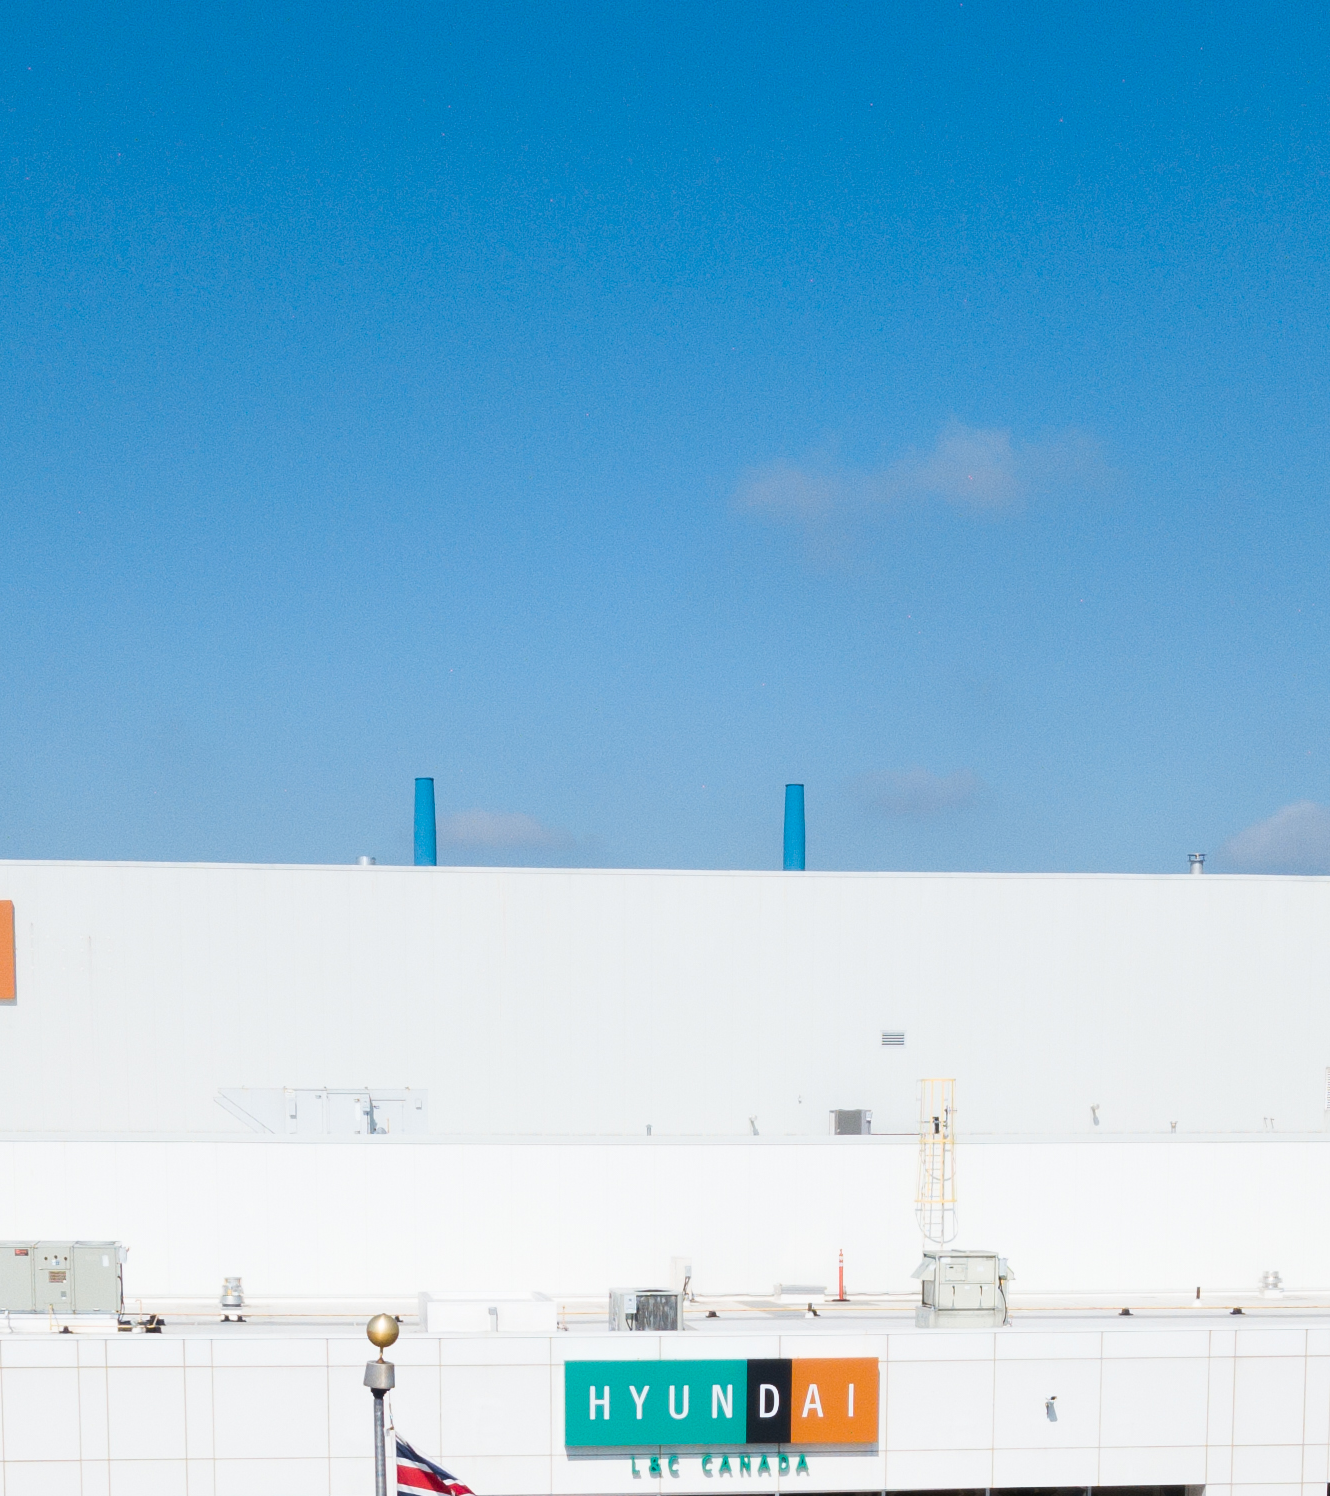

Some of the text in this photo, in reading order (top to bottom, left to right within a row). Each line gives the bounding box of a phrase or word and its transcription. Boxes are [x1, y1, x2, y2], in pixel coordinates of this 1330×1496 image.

[589, 1383, 855, 1420] HYUNDAI
[631, 1454, 809, 1476] L&C CANADA
